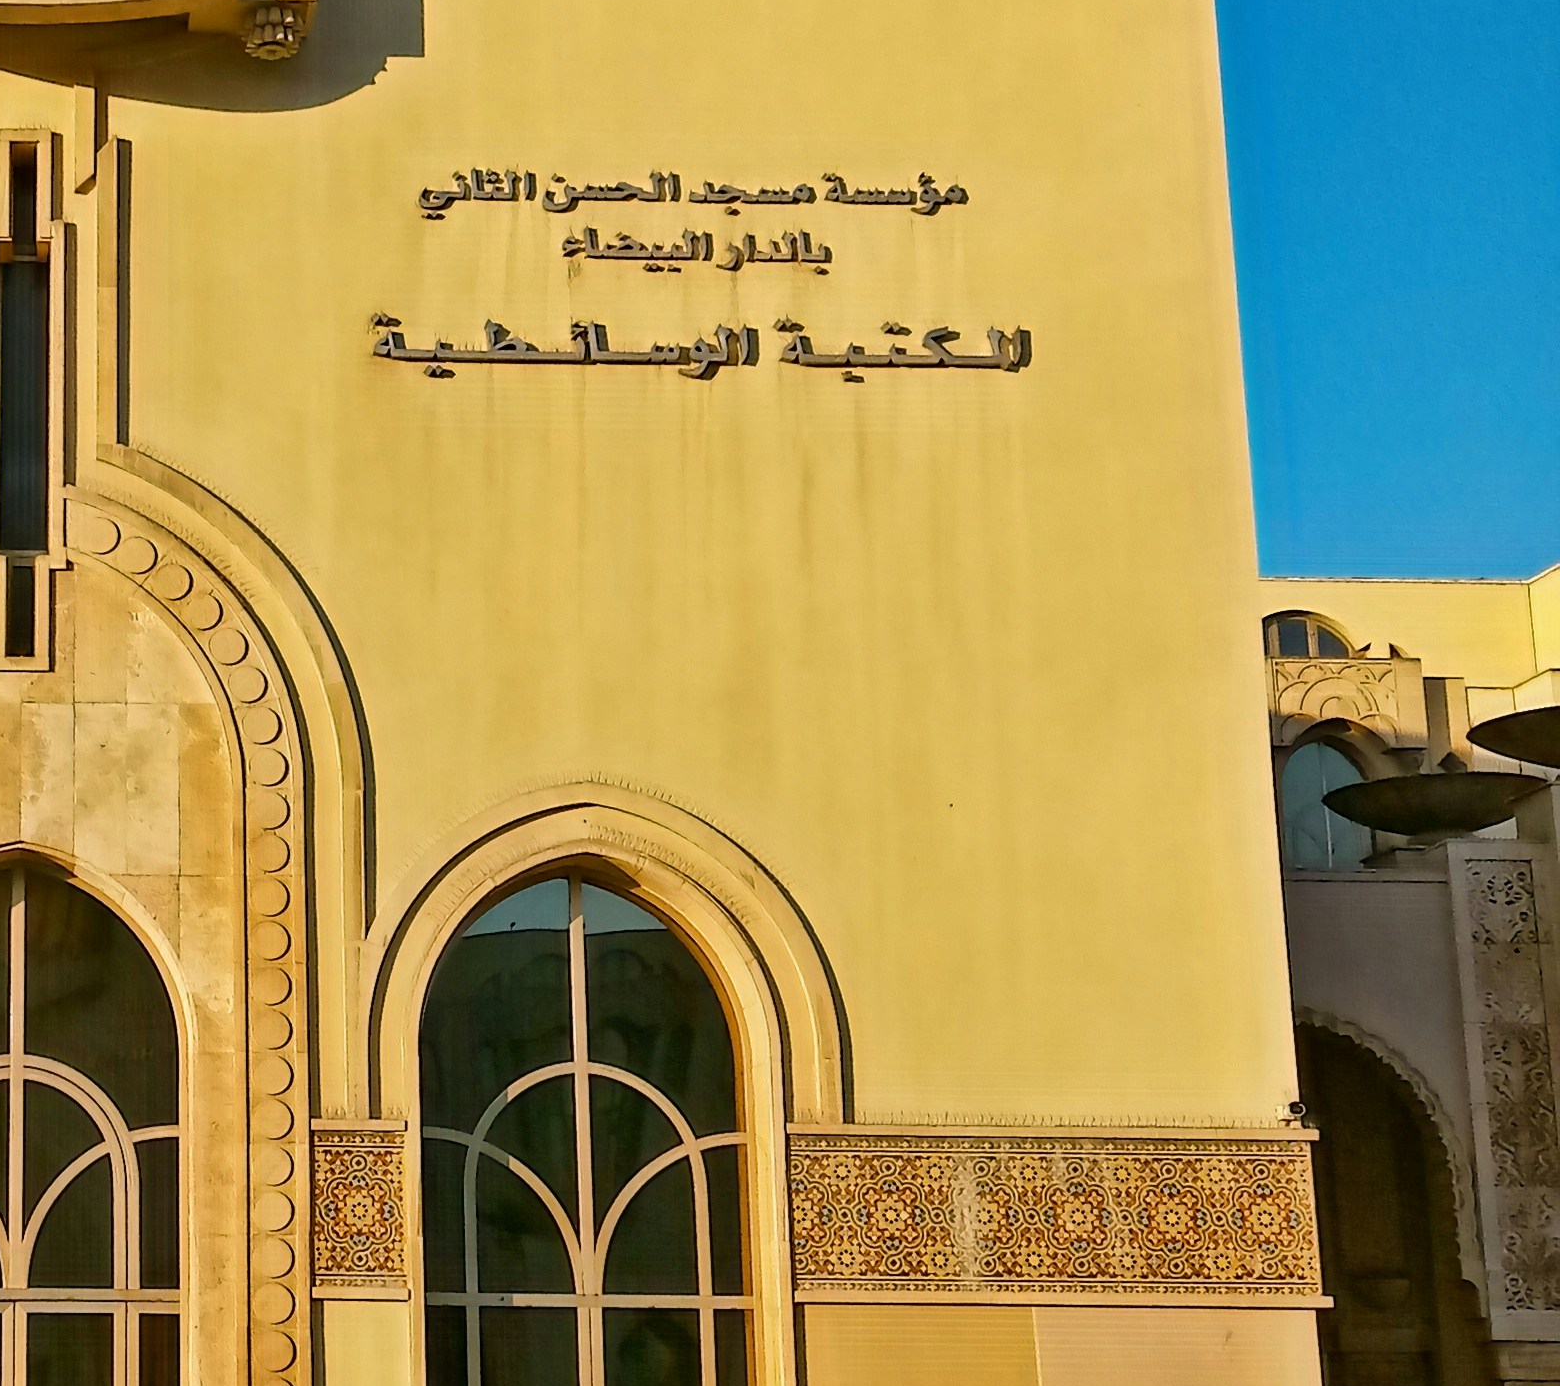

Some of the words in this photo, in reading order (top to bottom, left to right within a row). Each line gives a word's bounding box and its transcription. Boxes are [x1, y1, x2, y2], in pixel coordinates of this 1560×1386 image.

[418, 167, 536, 220] الثاني
[542, 171, 681, 213] الحسن
[689, 178, 816, 216] مسجد
[821, 172, 968, 216] مؤسسة
[561, 226, 714, 273] البيضاء
[716, 231, 831, 275] بالدار
[774, 317, 1031, 383] المكتبة
